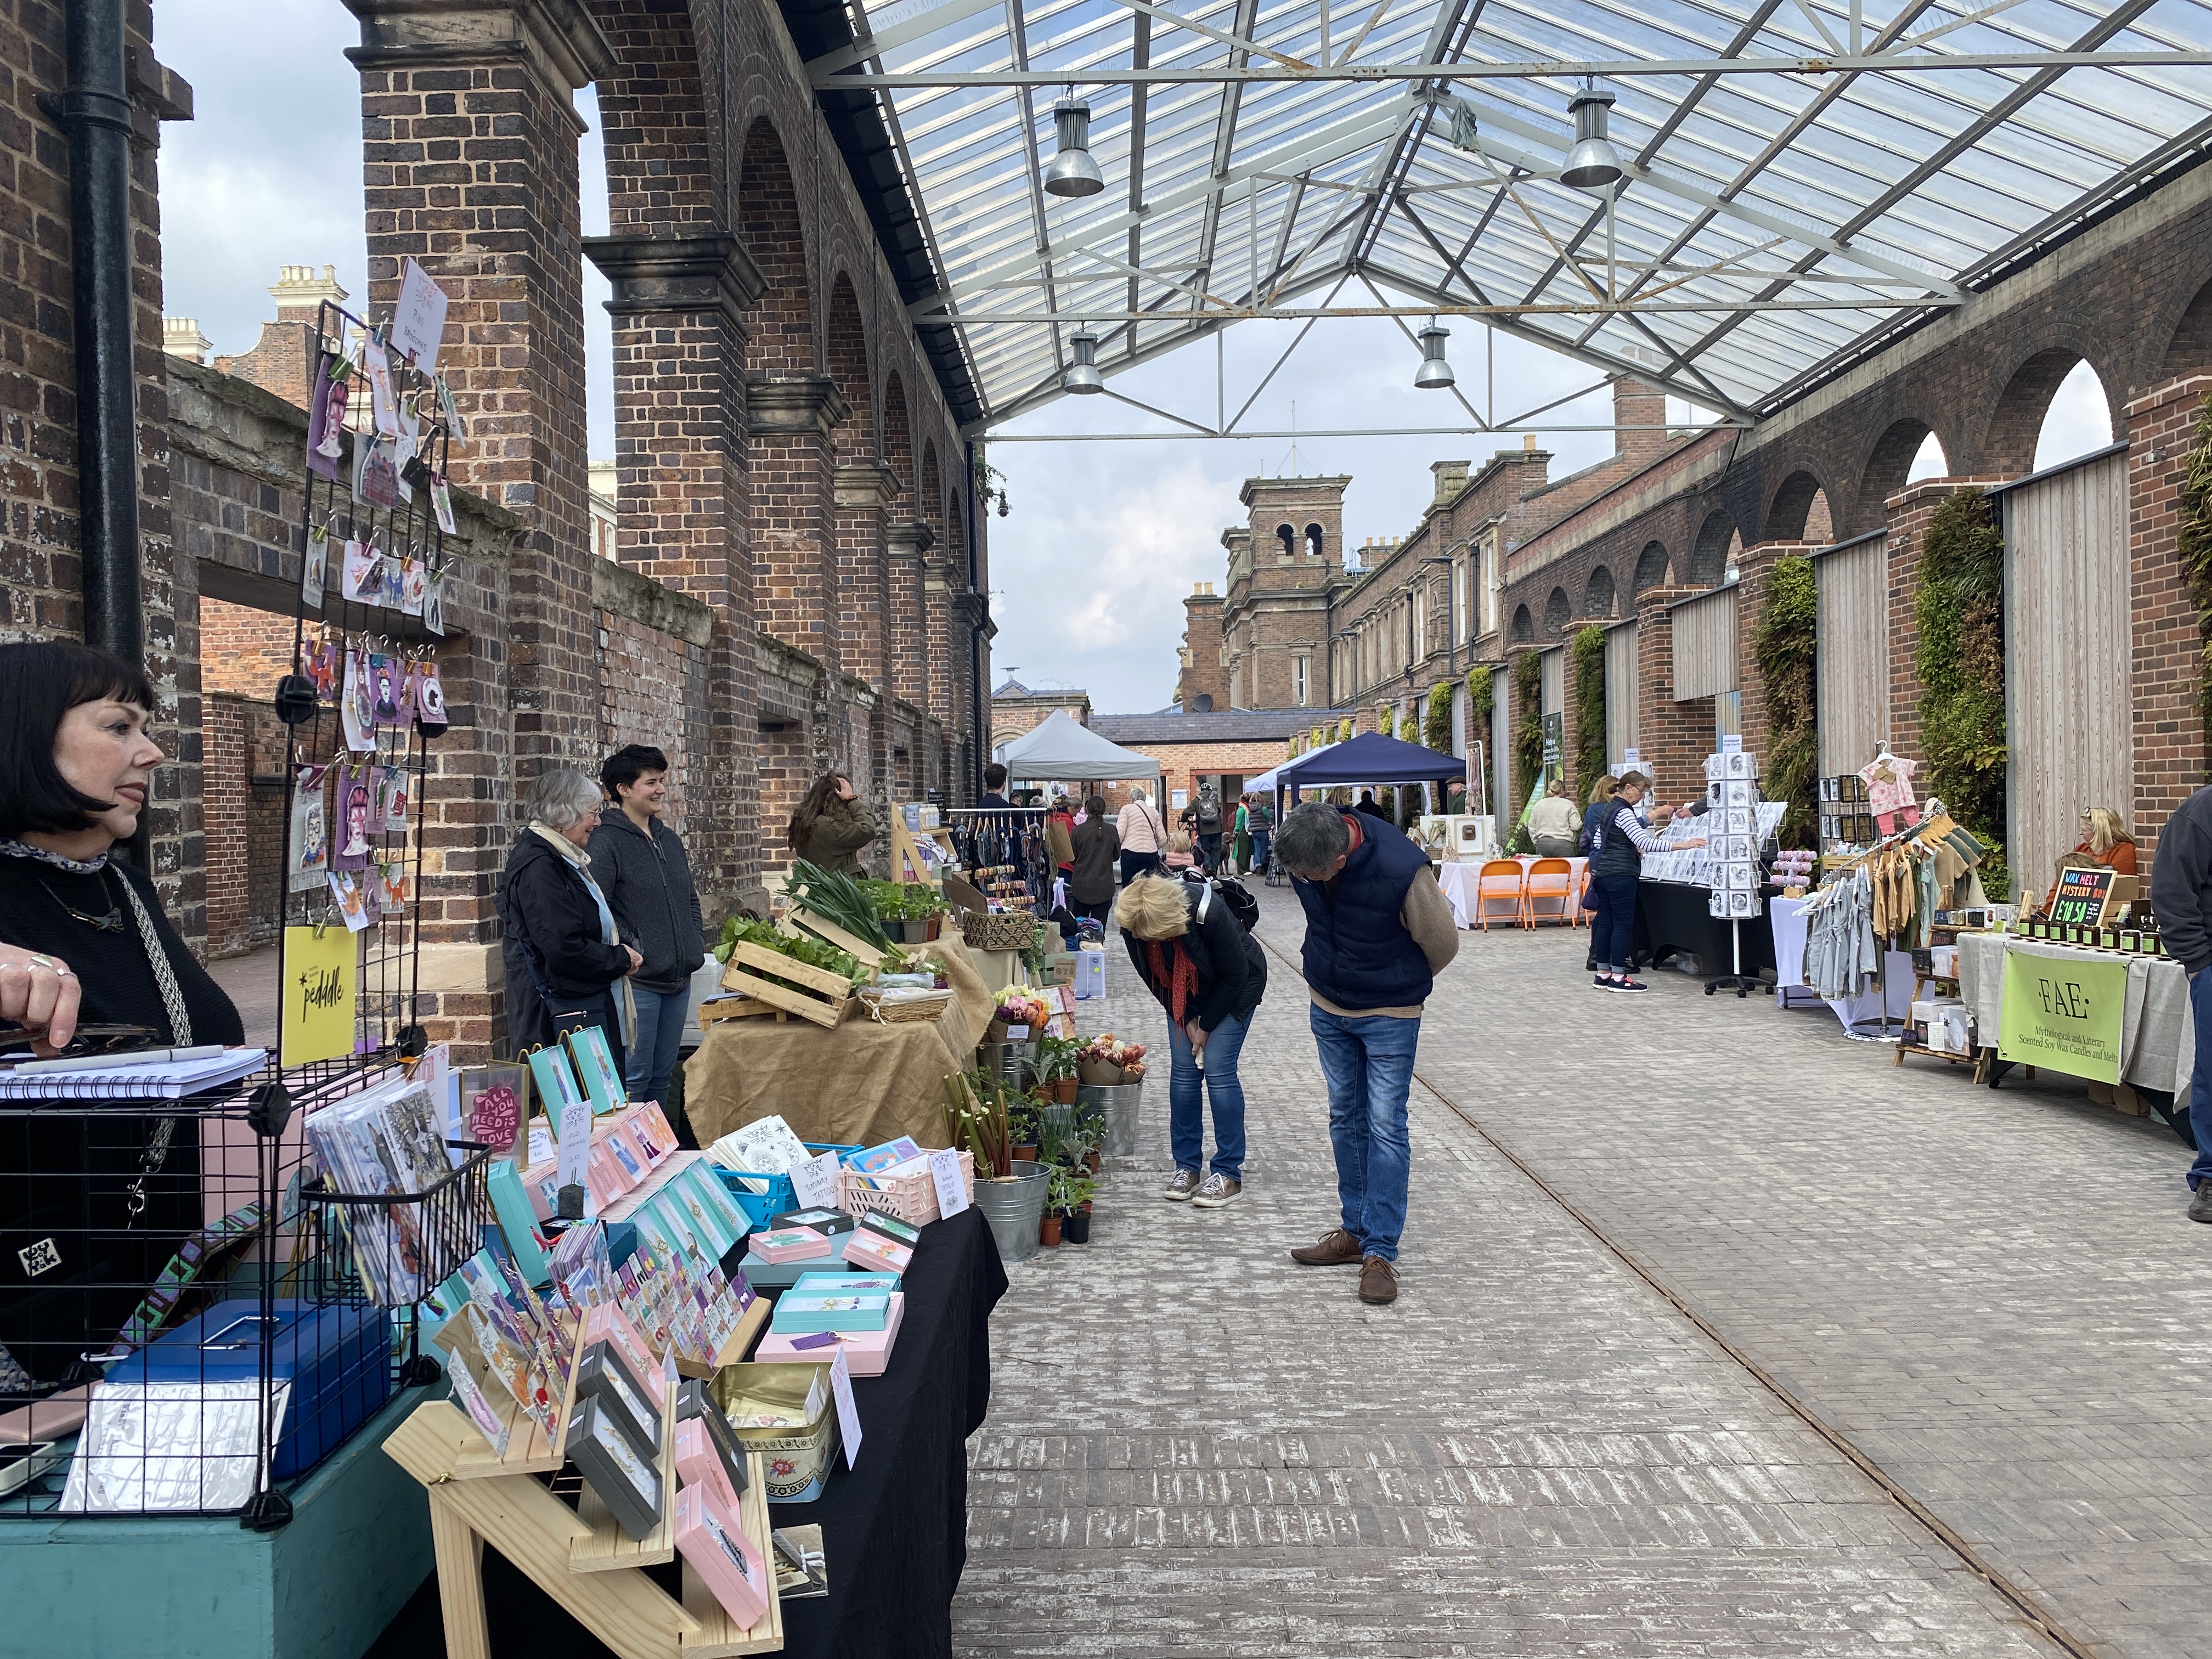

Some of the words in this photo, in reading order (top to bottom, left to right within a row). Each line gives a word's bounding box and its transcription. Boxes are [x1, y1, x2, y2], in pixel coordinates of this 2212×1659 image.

[404, 326, 426, 352] BROOCHES
[2065, 872, 2080, 884] WAX
[2079, 874, 2100, 885] MELT
[2062, 885, 2091, 897] MYSTERY
[2092, 888, 2106, 899] BOX
[2055, 900, 2087, 923] £10.50
[2035, 1025, 2070, 1042] Mythological
[2071, 1034, 2081, 1044] and
[2083, 1035, 2106, 1050] Literary
[2019, 1034, 2043, 1047] Scented
[2044, 1039, 2055, 1052] Soy
[2057, 1041, 2068, 1053] Wax
[2070, 1044, 2092, 1058] Candles
[2092, 1049, 2102, 1060] and
[2104, 1052, 2118, 1064] Melts
[484, 1090, 508, 1111] ALL
[492, 1098, 514, 1116] YOU
[472, 1114, 503, 1127] NEED
[482, 1129, 511, 1144] LOVE
[805, 1176, 828, 1191] TEMPORARY
[812, 1184, 838, 1201] TATTOOS
